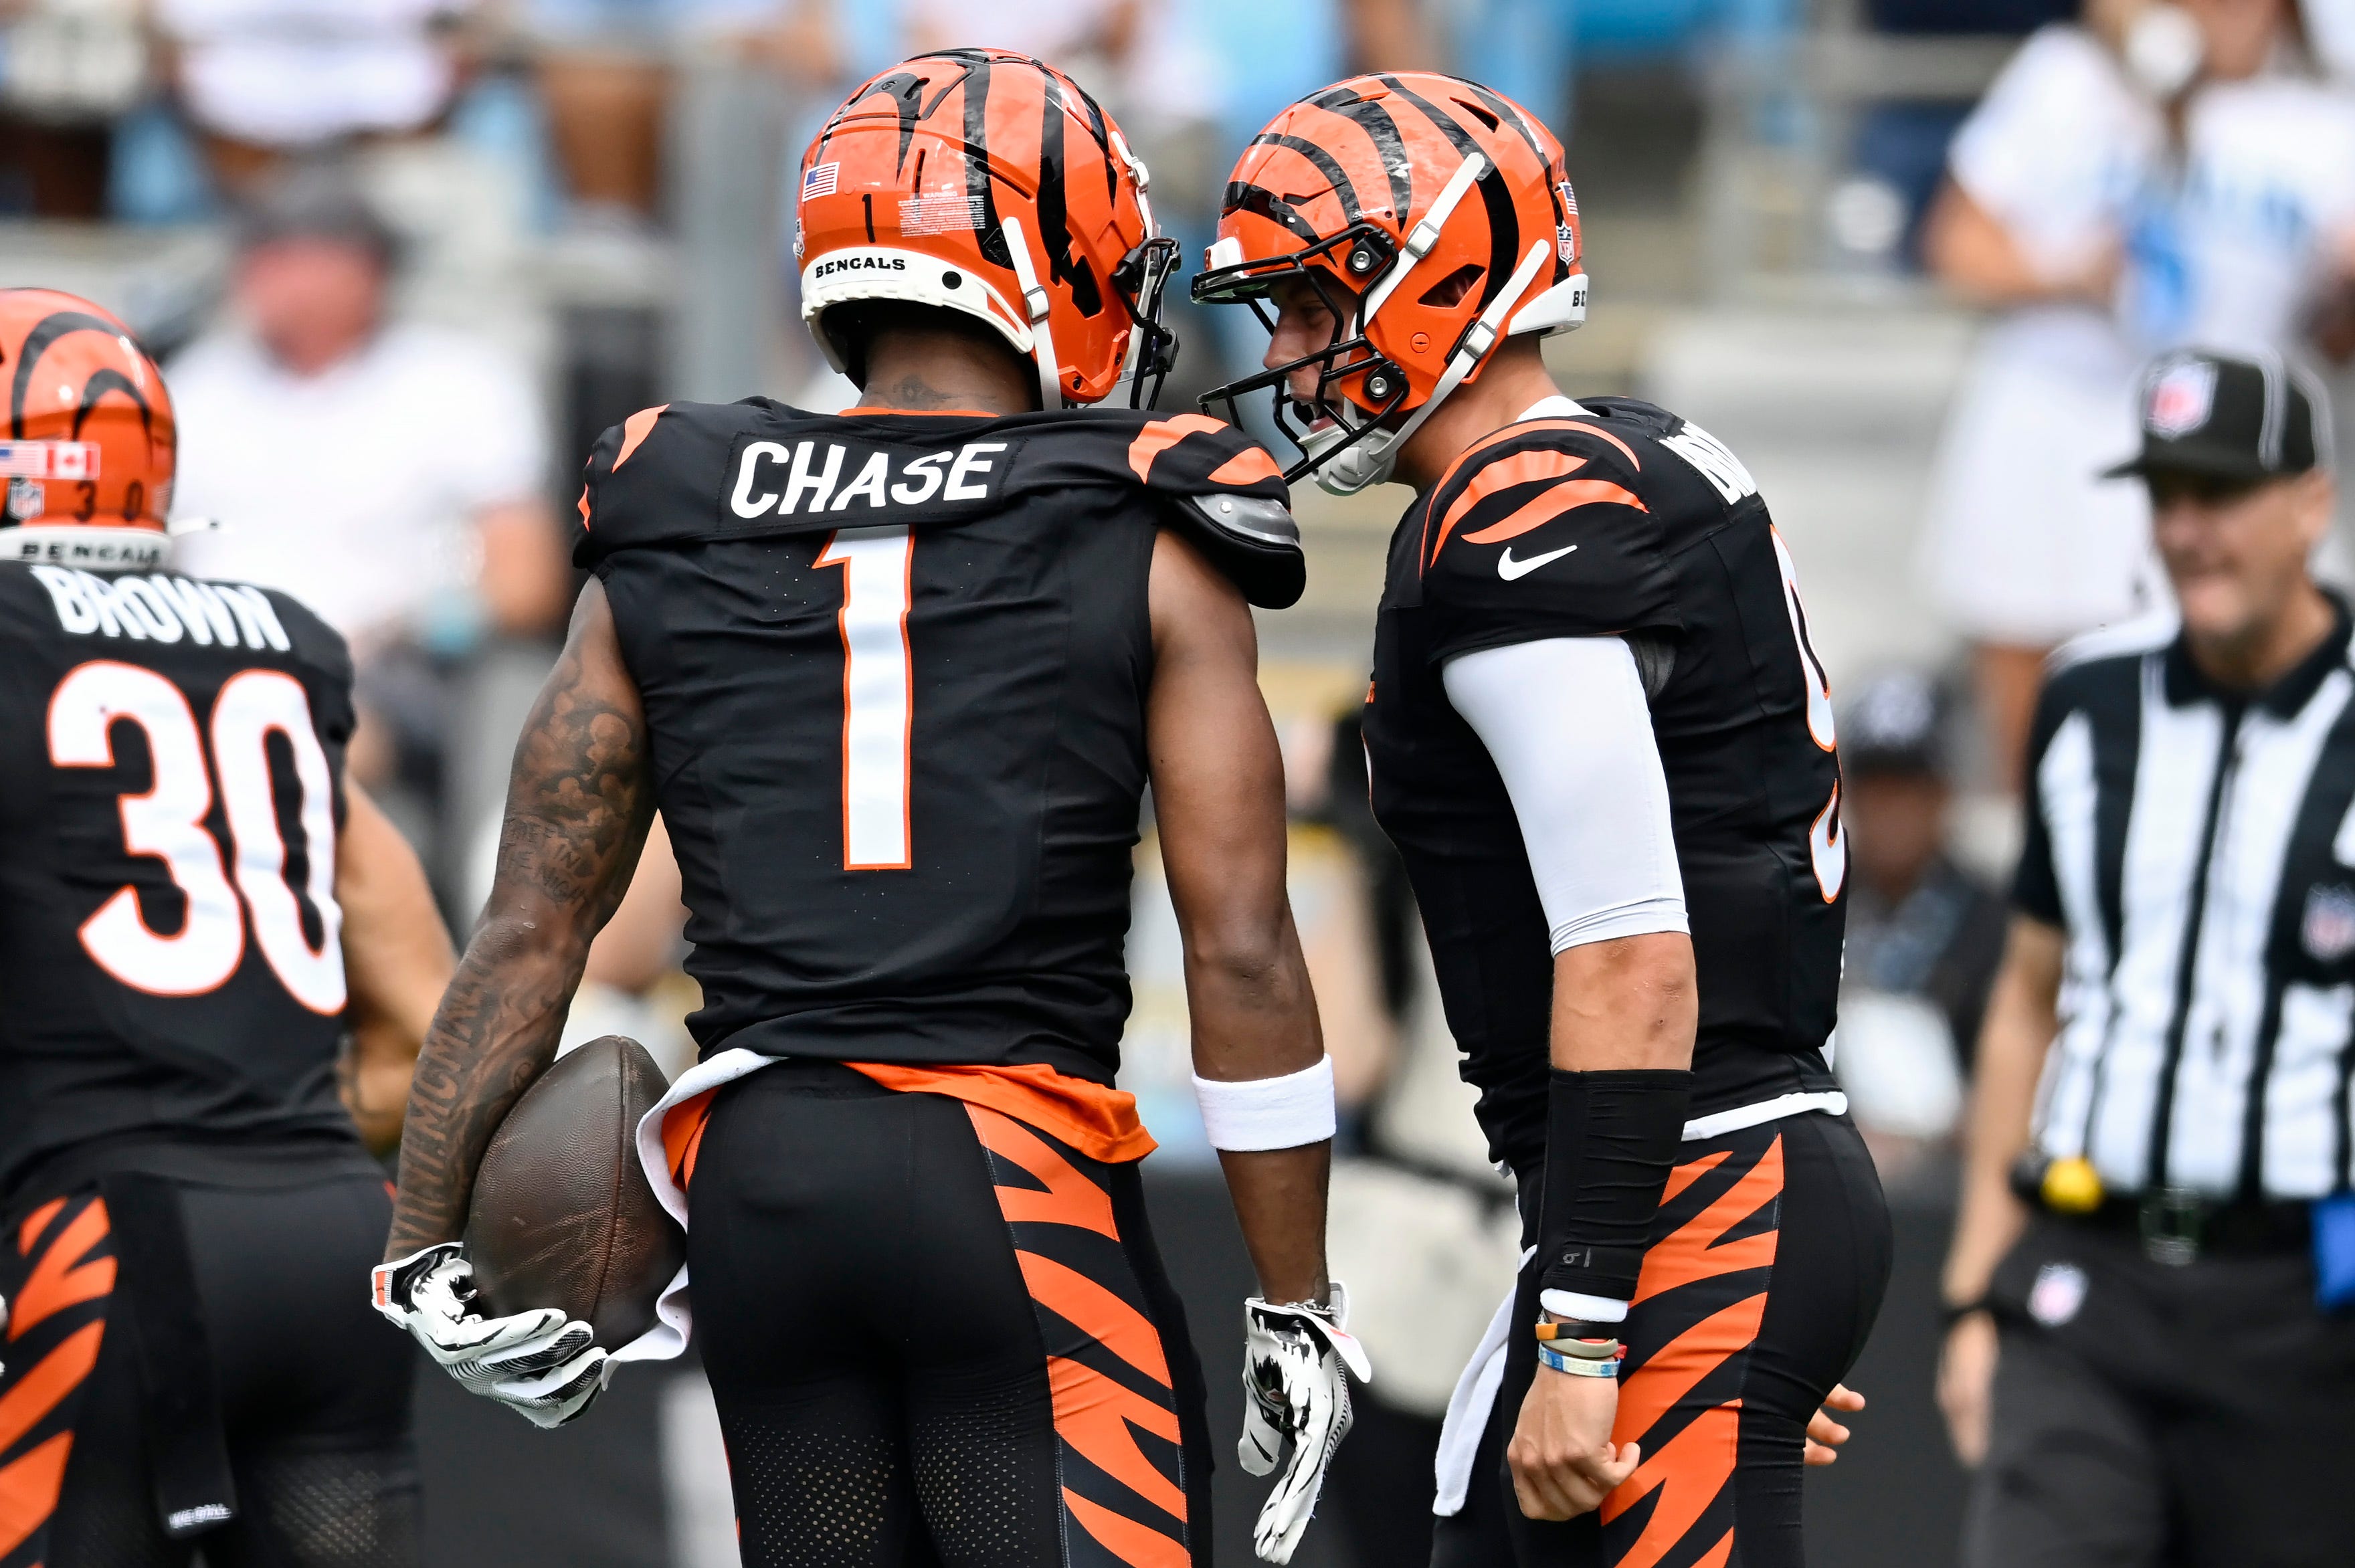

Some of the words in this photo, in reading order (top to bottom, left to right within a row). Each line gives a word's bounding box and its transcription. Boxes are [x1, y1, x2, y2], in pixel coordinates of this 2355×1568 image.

[815, 257, 906, 278] BENGALS
[731, 441, 1008, 519] CHASE
[29, 564, 291, 652] BROWN
[811, 524, 915, 870] 1
[46, 658, 348, 1017] 30
